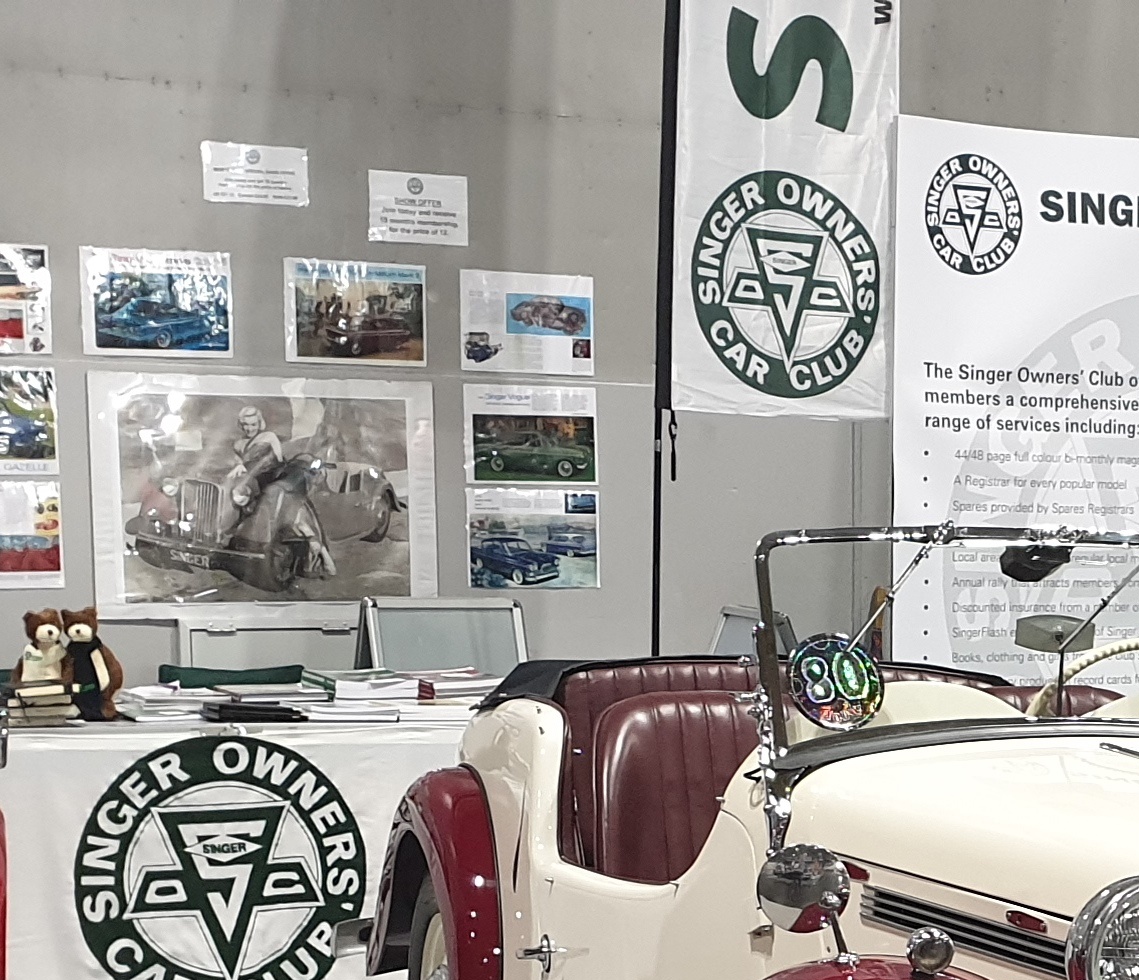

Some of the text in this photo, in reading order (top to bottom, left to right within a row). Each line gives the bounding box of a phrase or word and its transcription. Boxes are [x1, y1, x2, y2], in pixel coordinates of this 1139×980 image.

[727, 6, 853, 132] S
[926, 156, 1021, 236] SINGER OWNERS'
[698, 178, 876, 324] SINGER OWNERS'
[933, 233, 1015, 272] CAR CLUB
[710, 319, 864, 391] CAR CLUB
[924, 362, 953, 379] The
[958, 364, 1012, 386] Singer
[1017, 367, 1084, 386] Owners'
[1088, 370, 1124, 387] Club
[924, 390, 1139, 413] members a comprehensive
[925, 417, 970, 432] range
[976, 415, 992, 430] of
[996, 417, 1061, 433] services
[954, 450, 984, 461] 44/48
[986, 453, 1012, 464] page
[1014, 450, 1029, 462] full
[1031, 452, 1062, 463] colour
[953, 475, 1127, 492] A Registrar for every popular model
[952, 502, 1134, 518] Spares provided by Spares Registrars
[952, 552, 977, 562] Local
[1107, 552, 1129, 563] local
[952, 578, 988, 588] Annual
[988, 578, 1007, 589] rally
[1073, 578, 1118, 588] members
[952, 603, 1006, 614] Discounted
[1009, 603, 1056, 613] insurance
[1059, 603, 1083, 613] from
[1085, 605, 1091, 613] a
[1107, 629, 1138, 639] Singer
[952, 652, 984, 664] Books,
[986, 653, 1025, 665] clothing
[1028, 653, 1045, 662] and
[801, 651, 870, 703] 80
[1074, 676, 1105, 684] record
[1107, 674, 1133, 684] cards
[80, 741, 360, 923] SINGER OWNERS'
[202, 842, 247, 854] SINGER
